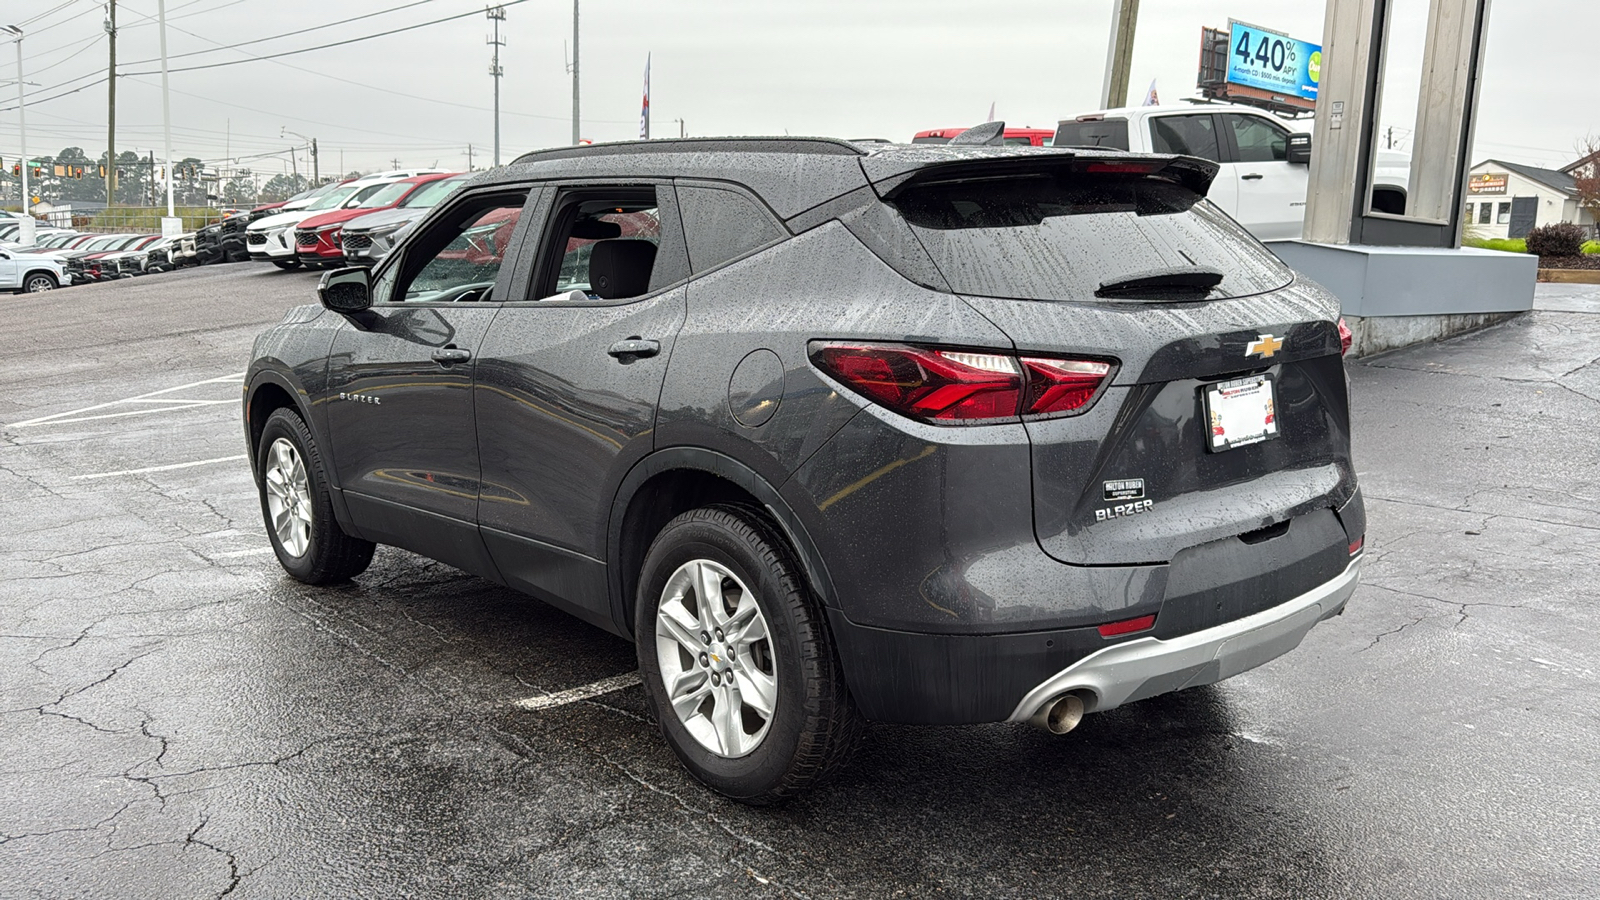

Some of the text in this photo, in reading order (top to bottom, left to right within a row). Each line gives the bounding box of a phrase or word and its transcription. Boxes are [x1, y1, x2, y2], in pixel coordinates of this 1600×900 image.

[1252, 69, 1258, 77] CD
[1260, 71, 1272, 80] $500
[1282, 76, 1297, 84] deposit
[340, 392, 380, 404] BLAZER
[1095, 500, 1152, 520] BLAZER
